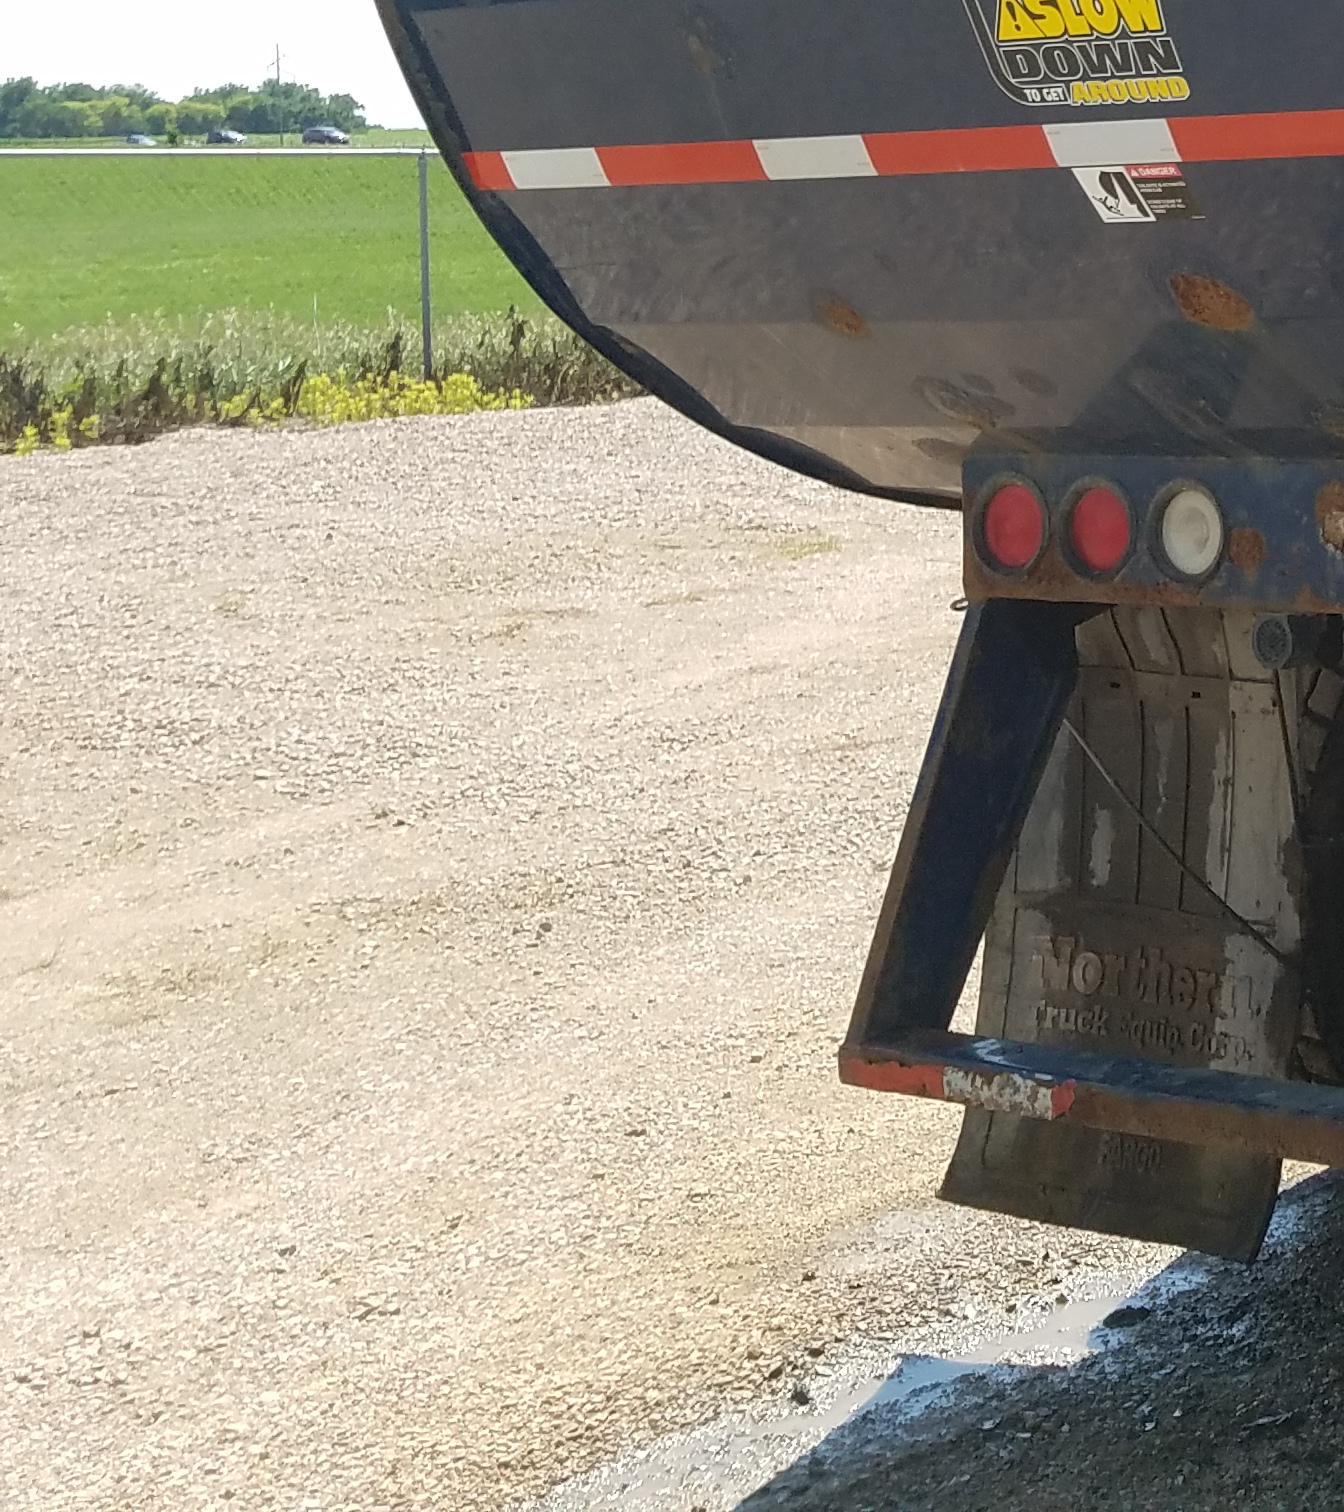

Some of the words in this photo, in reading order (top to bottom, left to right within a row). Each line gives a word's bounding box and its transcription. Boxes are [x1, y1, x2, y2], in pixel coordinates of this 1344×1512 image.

[1000, 38, 1183, 83] DOWN
[1024, 88, 1040, 102] TO
[1043, 87, 1067, 101] GET
[1072, 77, 1190, 105] AROUND
